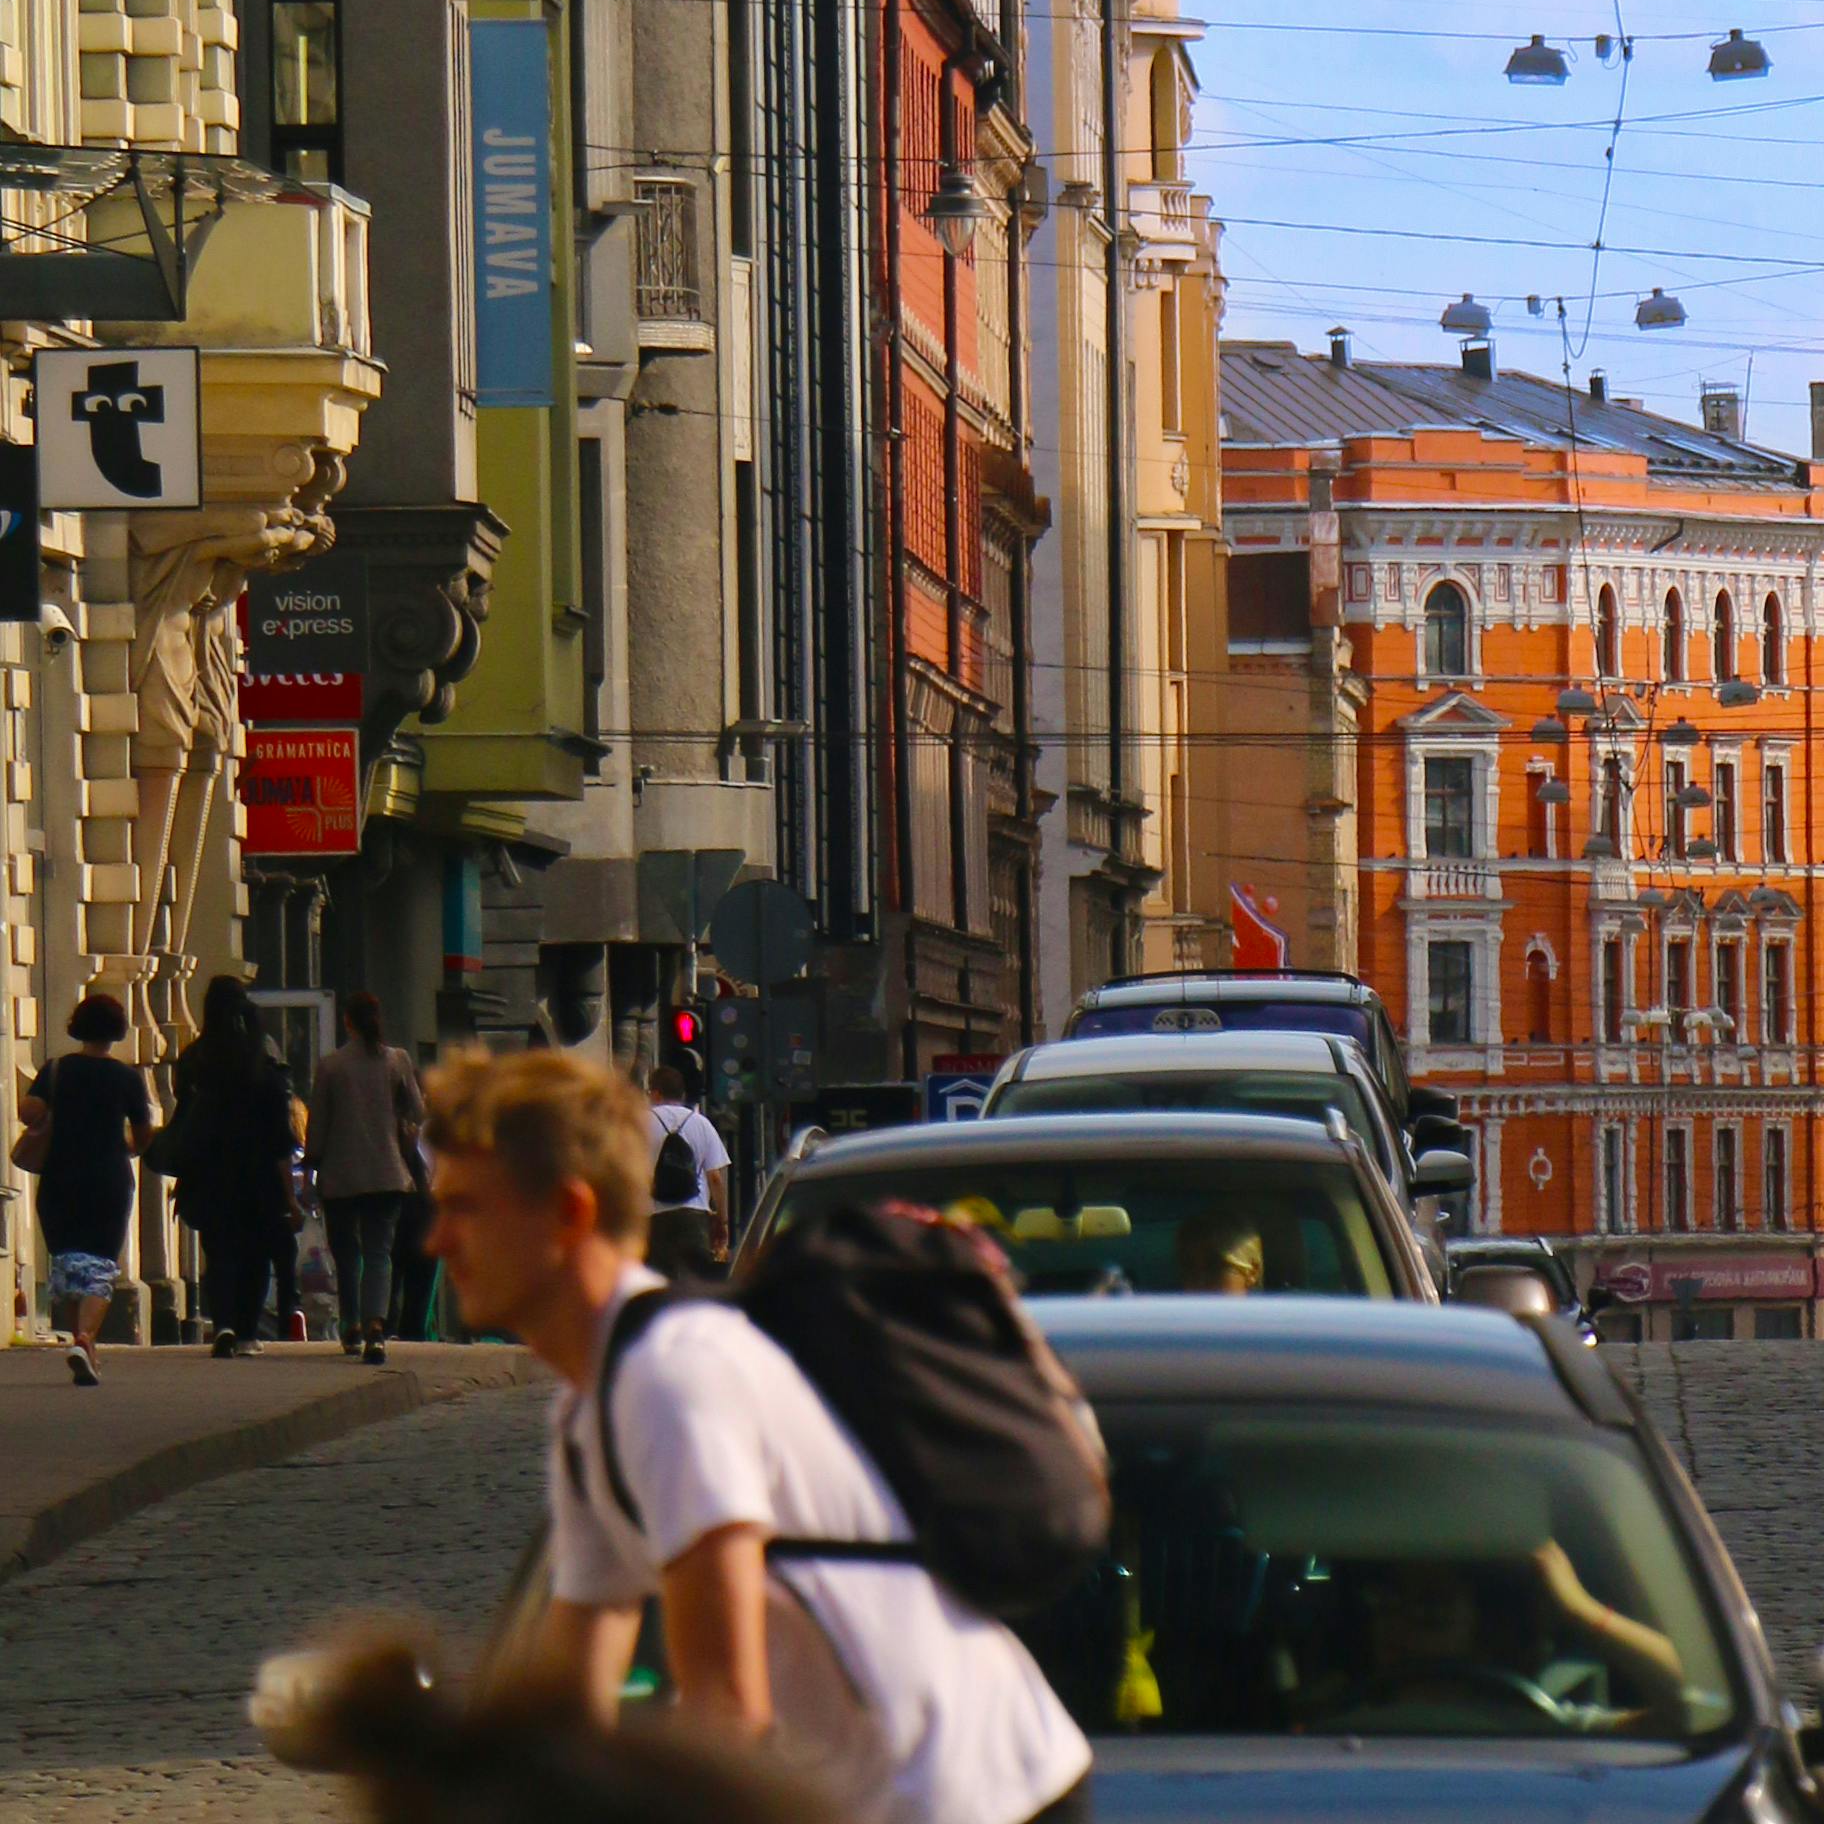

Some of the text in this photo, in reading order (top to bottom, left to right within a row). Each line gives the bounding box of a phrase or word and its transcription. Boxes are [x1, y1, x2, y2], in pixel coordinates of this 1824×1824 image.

[483, 128, 539, 299] JUMAVA
[274, 590, 341, 611] vision
[262, 618, 354, 640] express
[256, 739, 351, 759] GRĀMATNĪCA
[324, 815, 353, 830] PLUS
